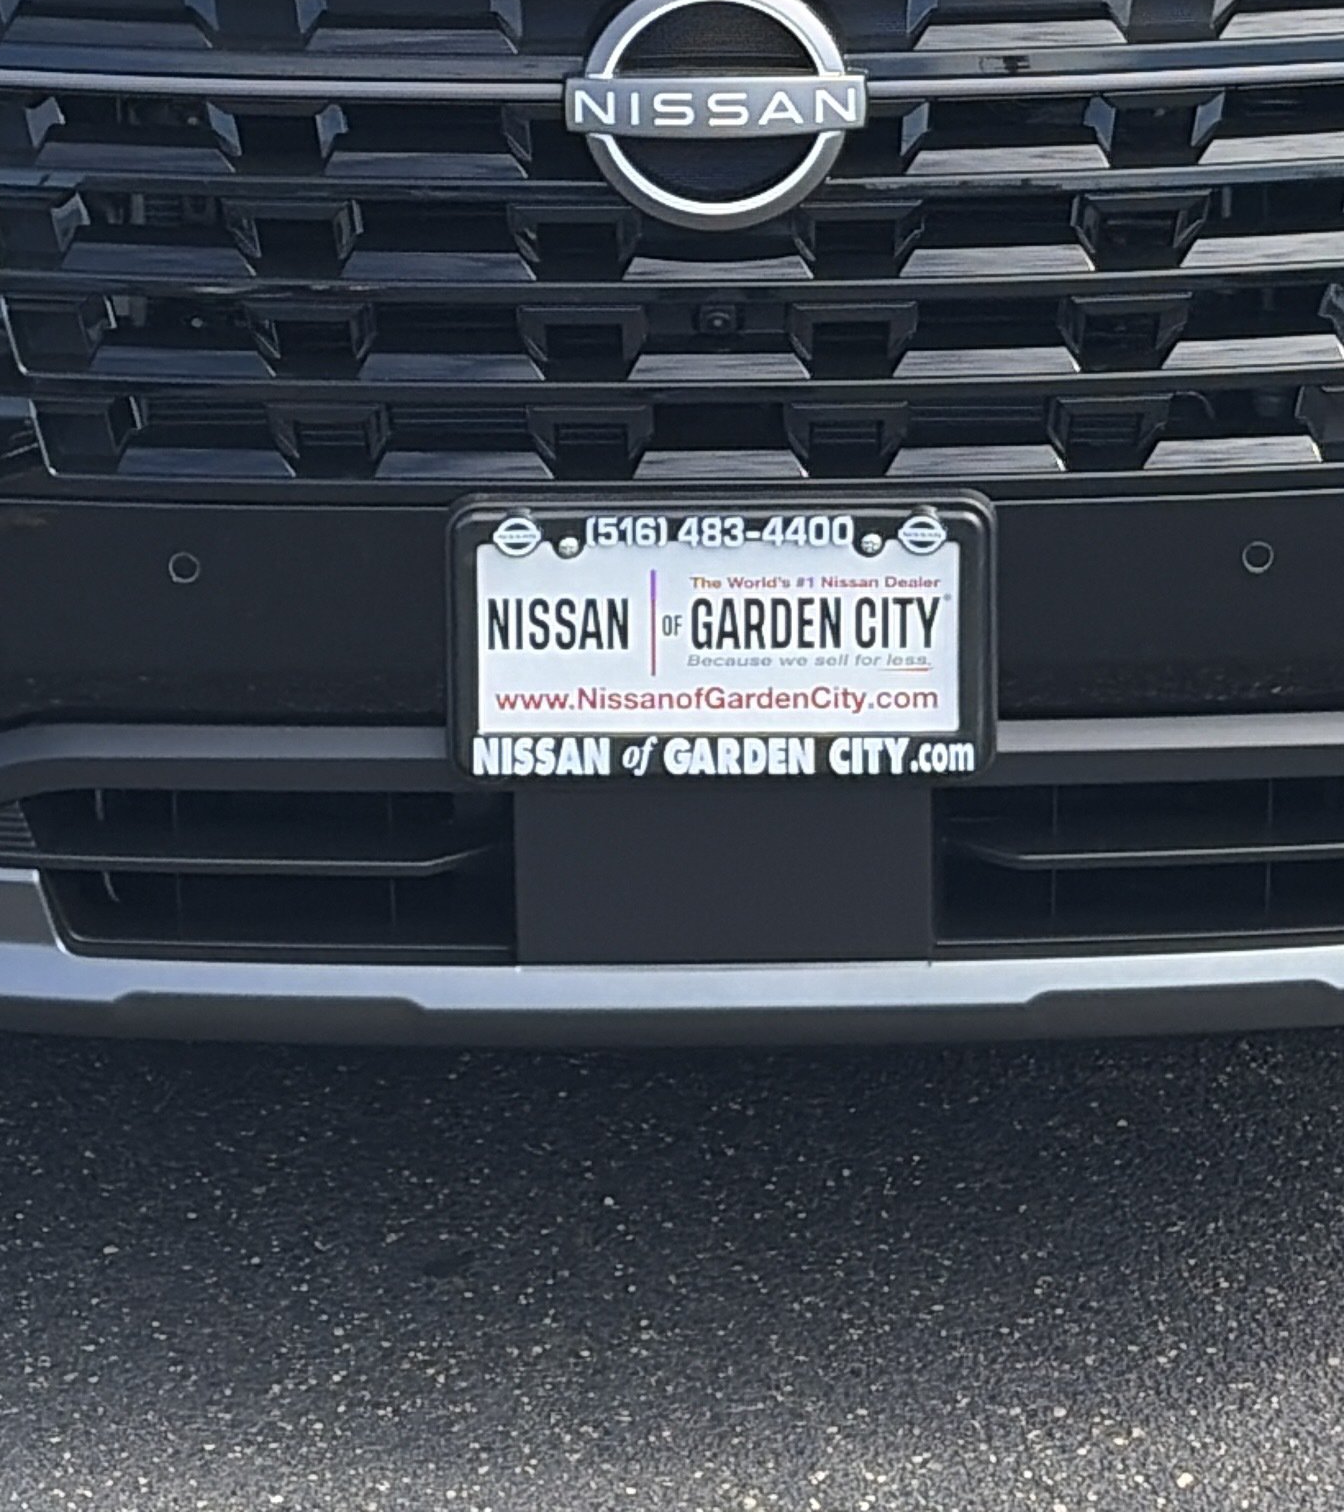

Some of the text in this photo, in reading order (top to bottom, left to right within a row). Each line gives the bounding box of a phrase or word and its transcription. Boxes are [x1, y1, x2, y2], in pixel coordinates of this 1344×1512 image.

[574, 87, 857, 127] NISSAN
[585, 515, 855, 548] (516) 483-4400
[690, 576, 942, 589] The World's #1 Nissan Dealer
[487, 596, 941, 650] NISSAN OF GARDEN CITY
[687, 654, 932, 667] Because we sell for less.
[495, 687, 939, 714] www.NissanofGardenCity.com
[472, 736, 976, 777] NISSAN of GARDEN CITY.com
